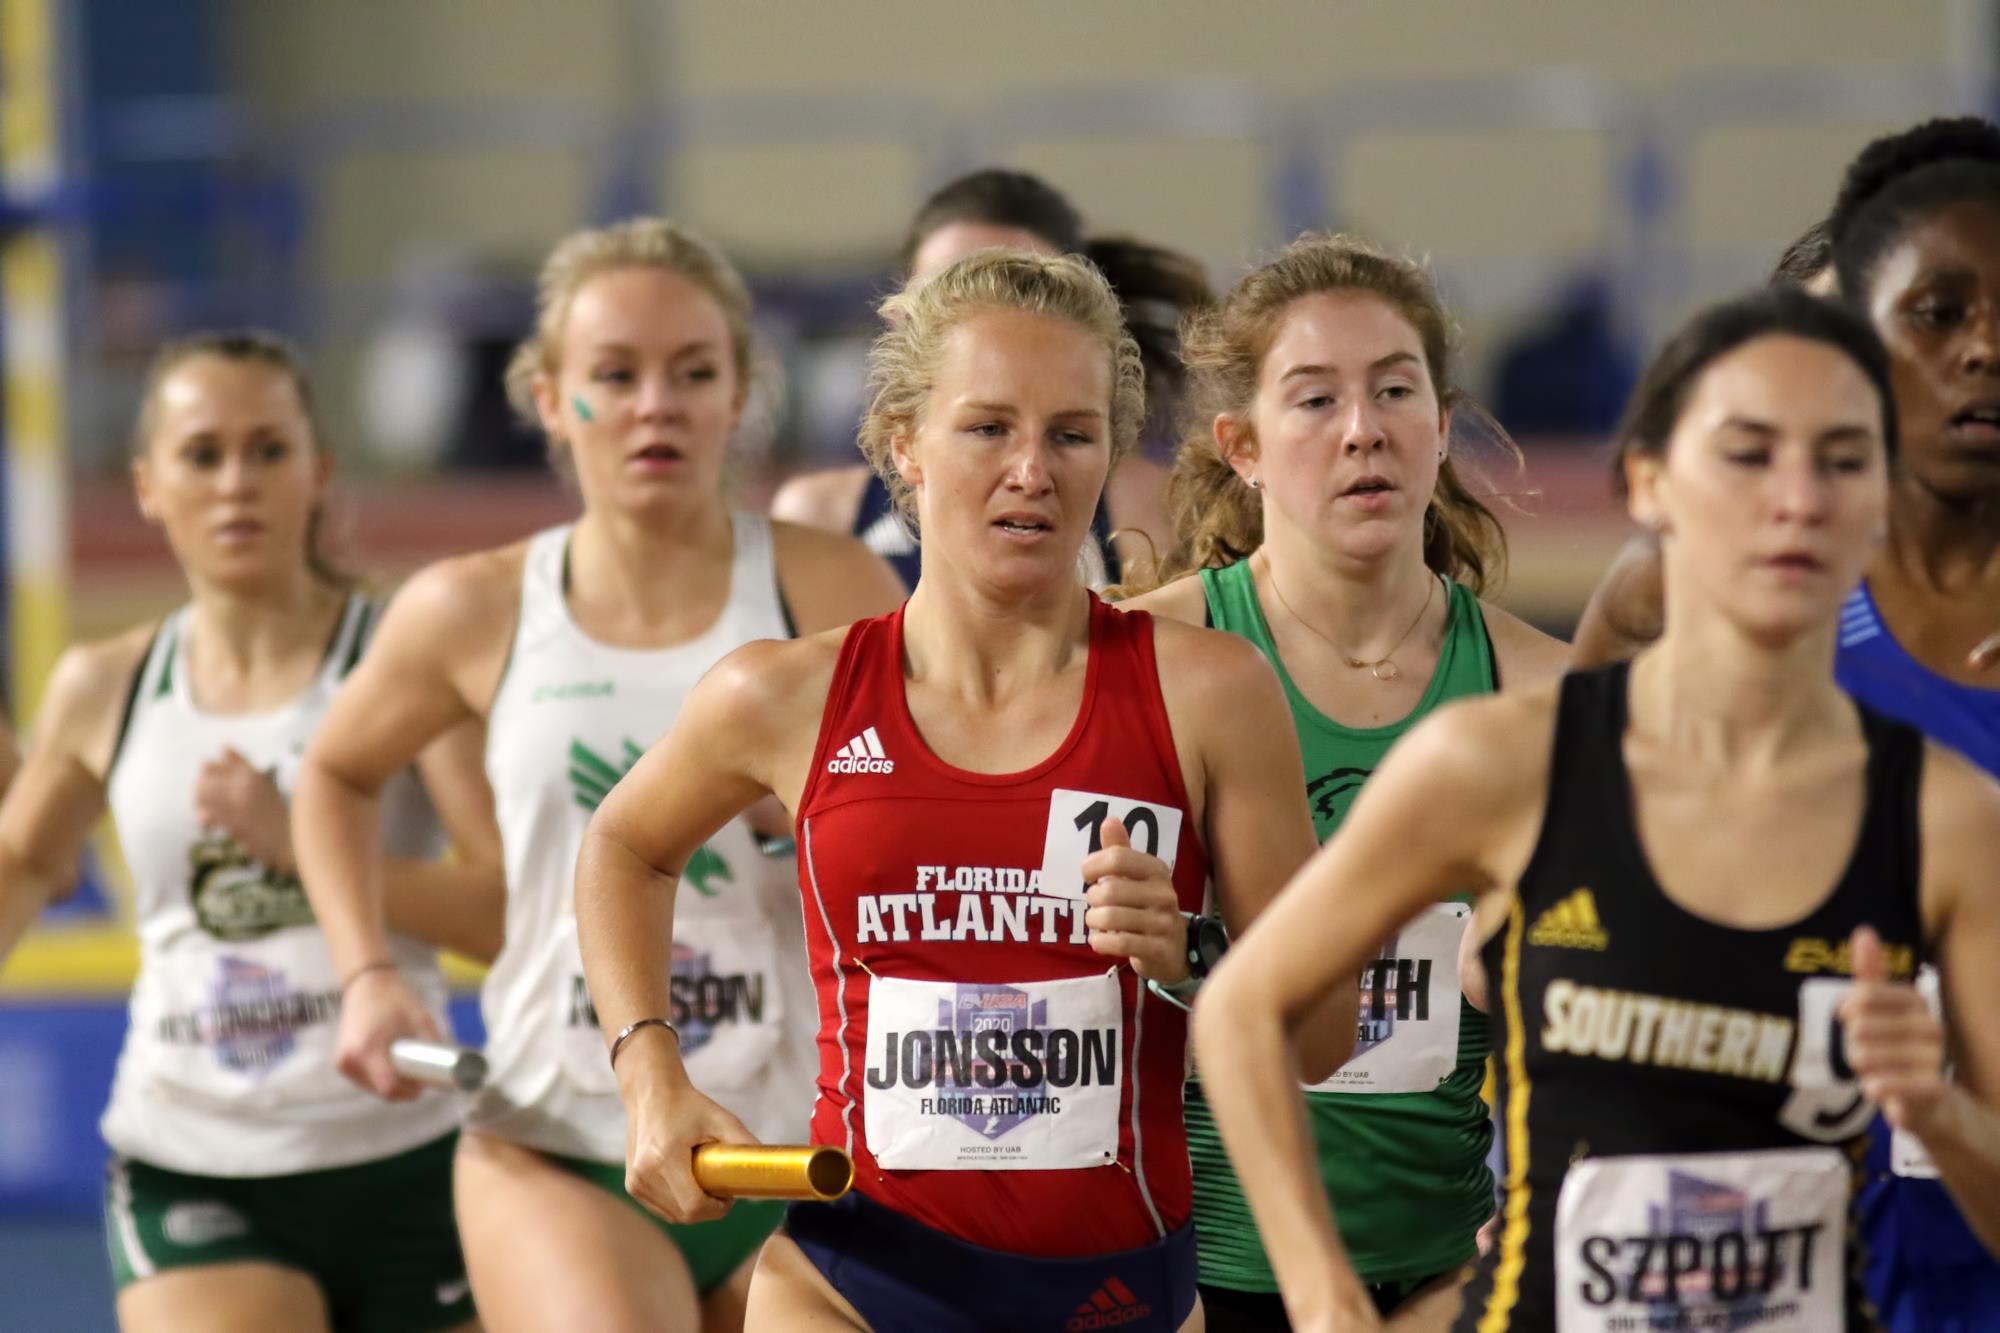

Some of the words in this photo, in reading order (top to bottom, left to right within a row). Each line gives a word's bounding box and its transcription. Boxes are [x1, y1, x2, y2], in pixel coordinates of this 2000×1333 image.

[828, 756, 894, 774] adidas
[1073, 800, 1160, 893] 10
[916, 865, 1042, 894] FLORIDA
[856, 894, 1090, 945] ATLANTI
[1364, 959, 1432, 1021] TH
[1542, 977, 1793, 1082] SOUTHERN
[867, 1029, 1116, 1090] JONSSON
[921, 1099, 982, 1115] FLORIDA
[990, 1097, 1060, 1115] ATLANTIC
[960, 1146, 991, 1154] HOSTED
[993, 1146, 1004, 1154] BY
[1005, 1146, 1022, 1154] UAB
[1580, 1222, 1824, 1306] SZPOTT
